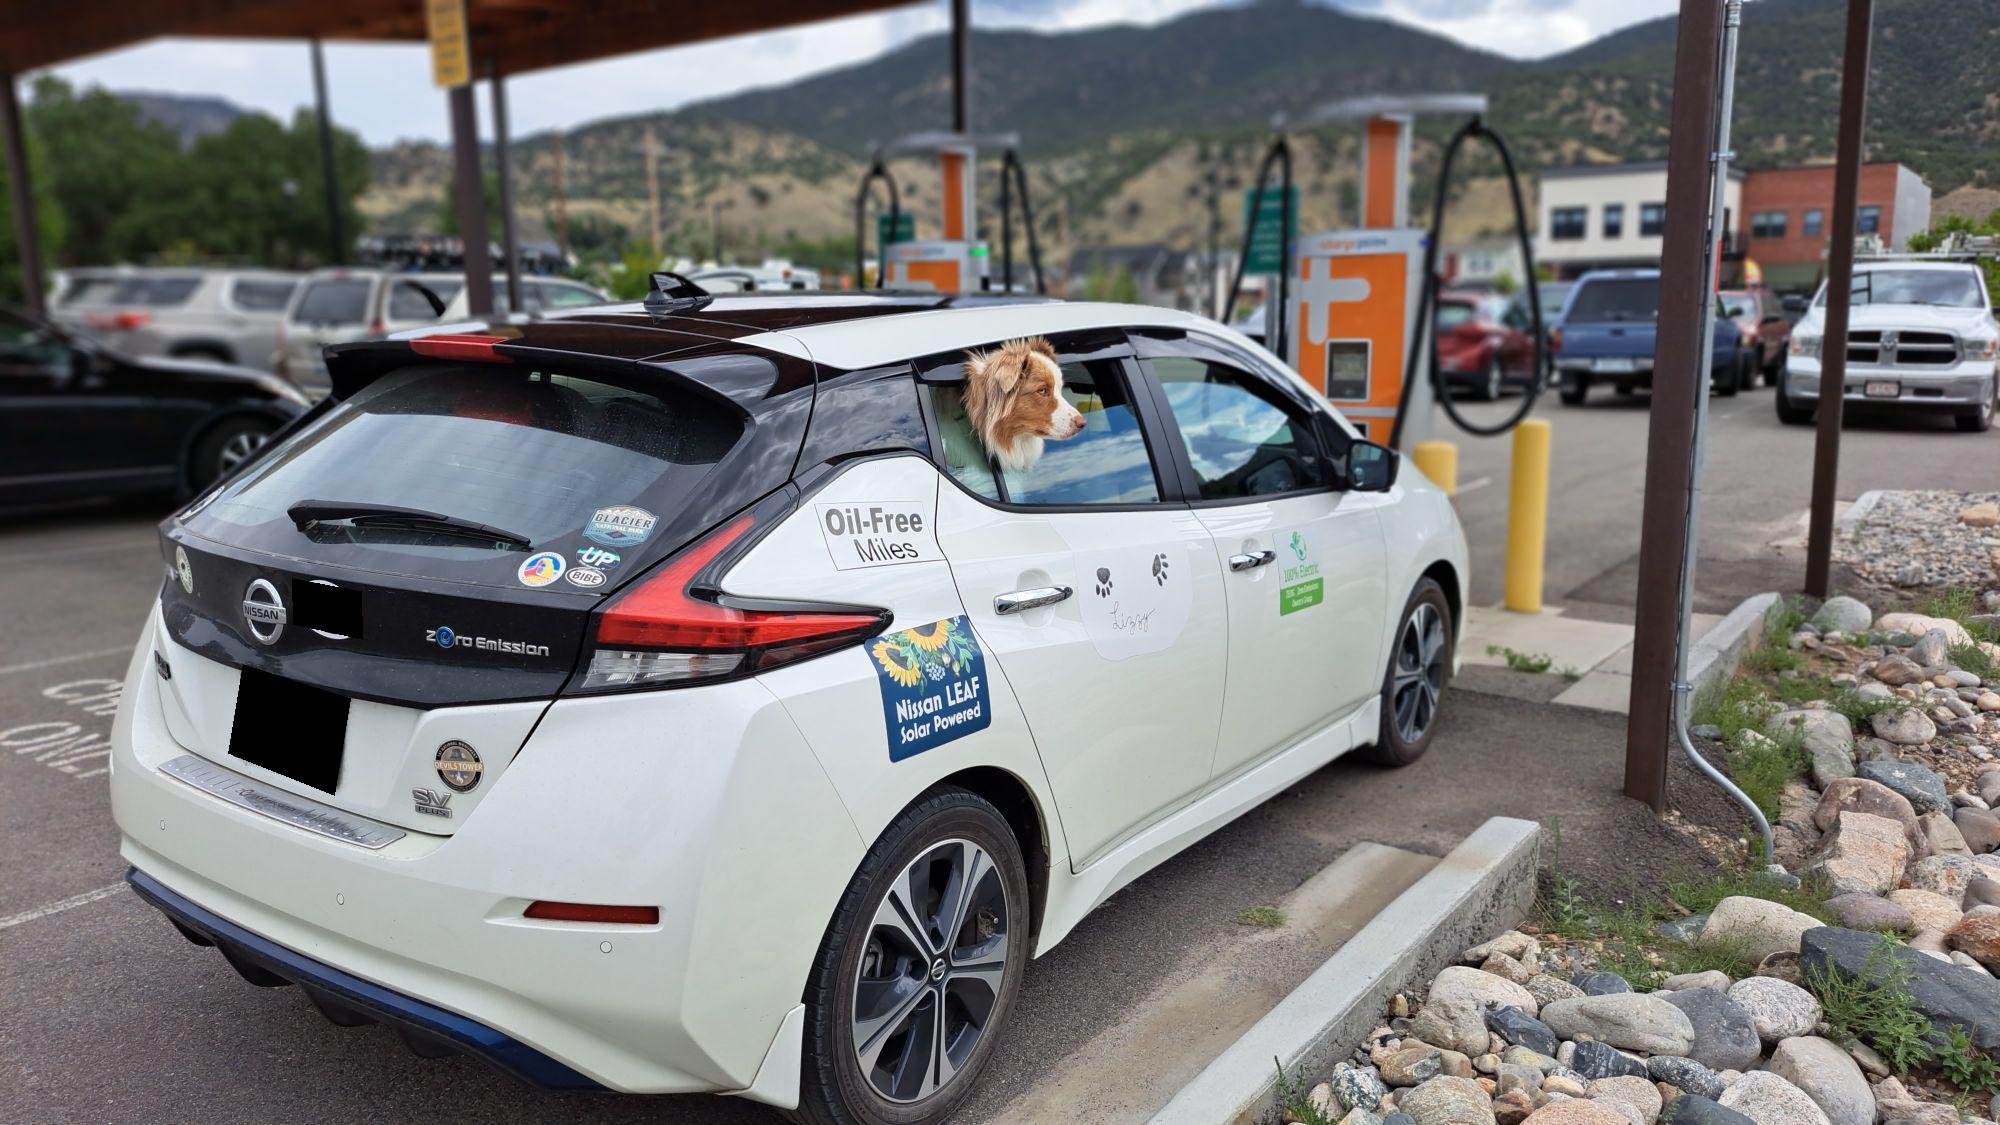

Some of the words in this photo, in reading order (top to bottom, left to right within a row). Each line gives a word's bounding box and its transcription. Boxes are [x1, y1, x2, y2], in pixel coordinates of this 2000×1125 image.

[595, 513, 652, 528] GLACIER
[825, 507, 923, 536] Oil-Free
[581, 546, 616, 567] UP
[853, 538, 919, 562] Miles
[572, 571, 600, 584] BIBE
[1284, 567, 1299, 583] 100%
[244, 605, 279, 620] NISSAN
[1109, 600, 1156, 635] Lizzy
[895, 694, 943, 724] Nissan
[945, 676, 980, 707] LEAF
[901, 722, 931, 744] Solar
[933, 701, 981, 733] Powered
[435, 761, 458, 770] DEVILS
[459, 762, 483, 771] TOWER
[412, 787, 451, 808] SV
[418, 805, 446, 817] PLUS
